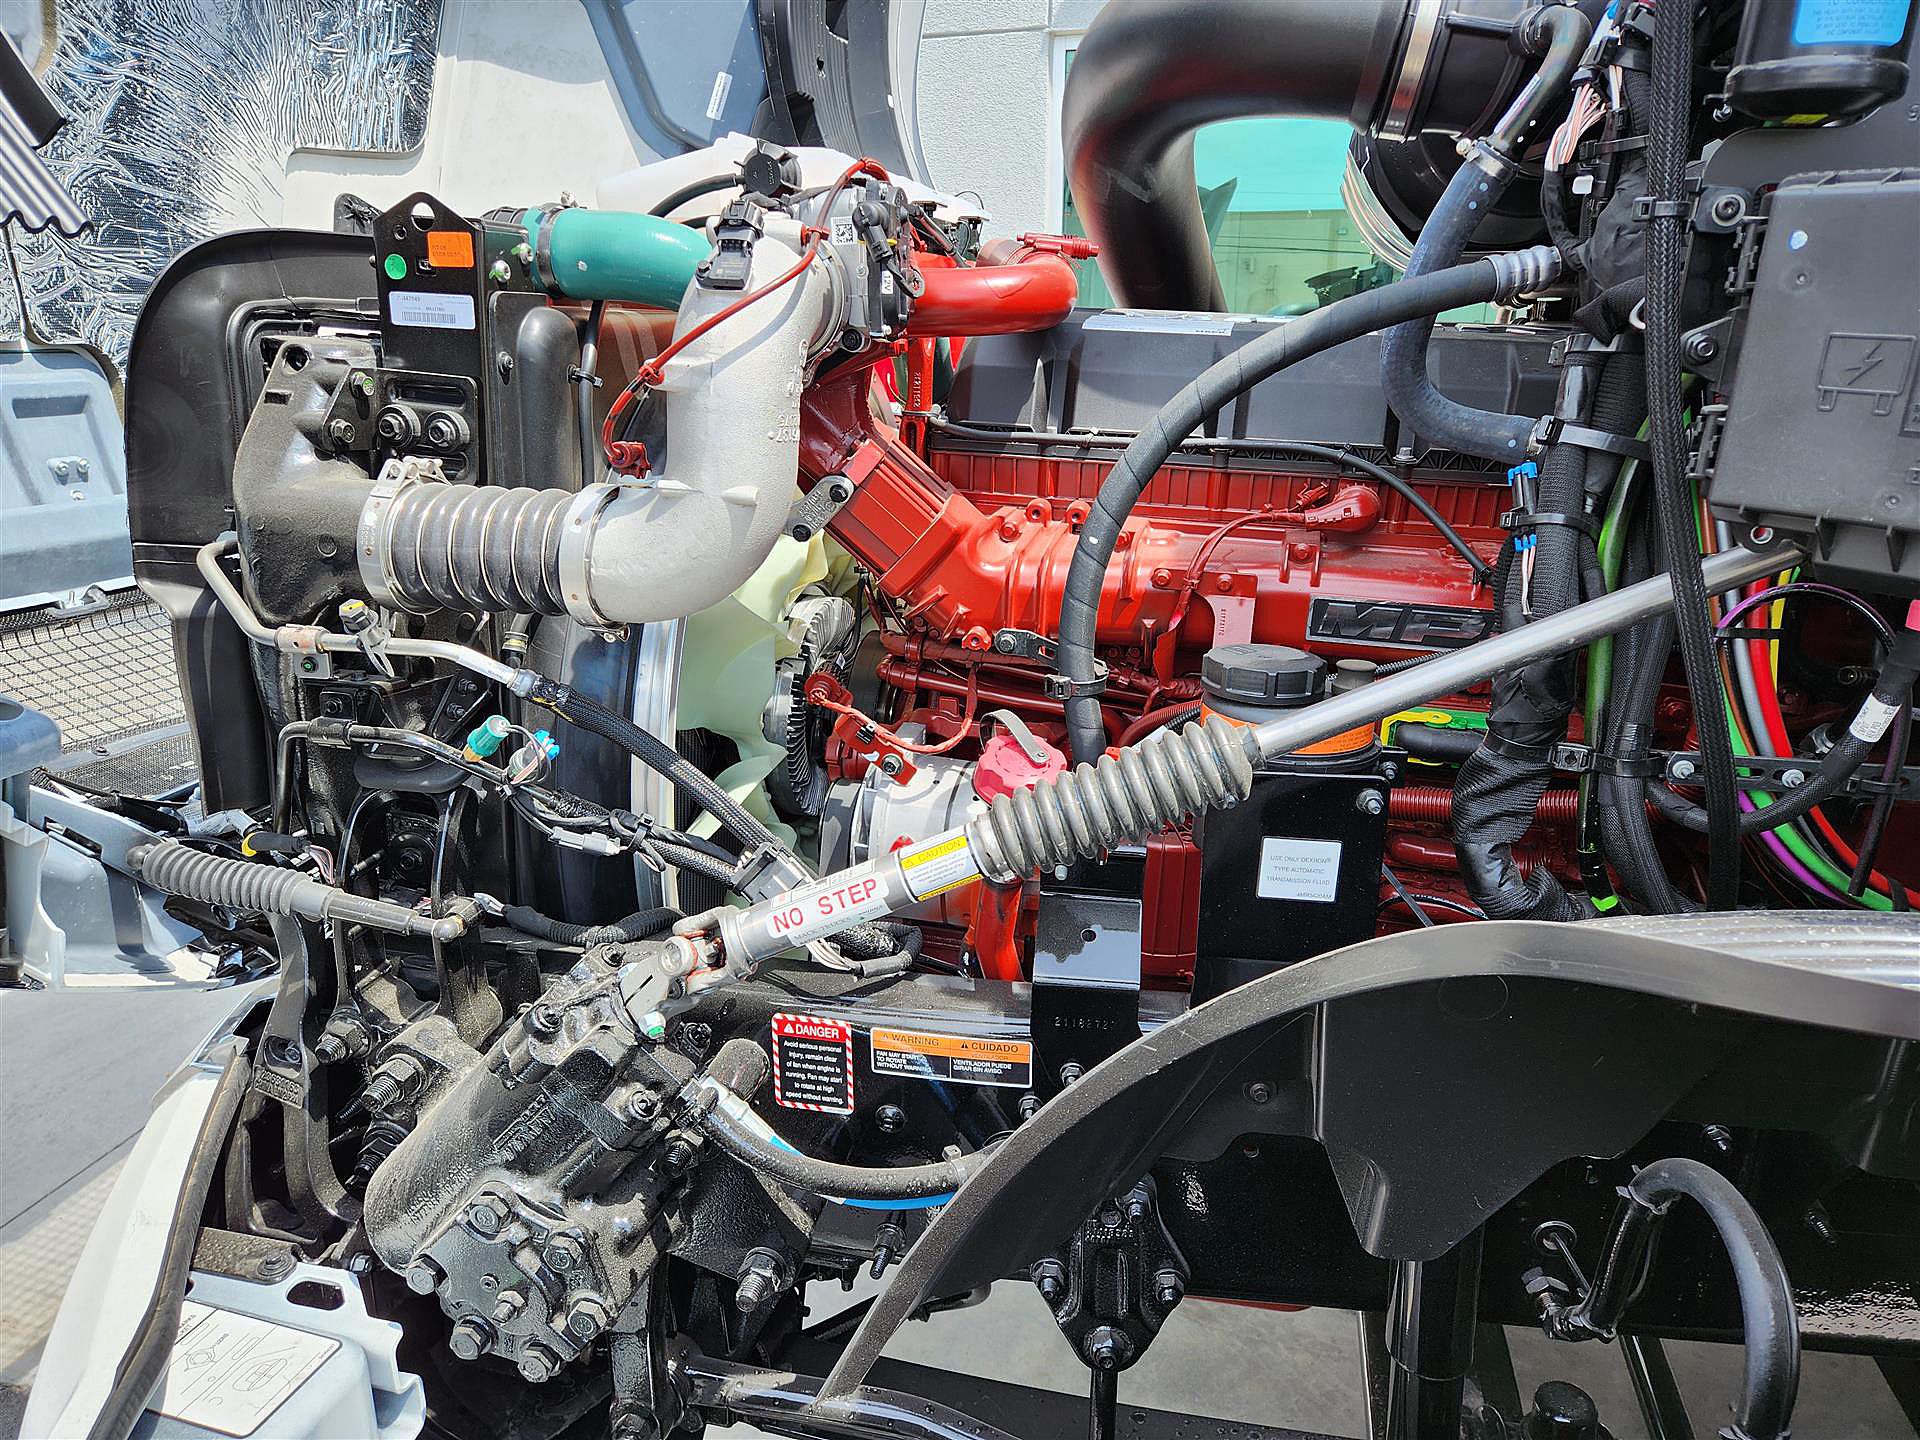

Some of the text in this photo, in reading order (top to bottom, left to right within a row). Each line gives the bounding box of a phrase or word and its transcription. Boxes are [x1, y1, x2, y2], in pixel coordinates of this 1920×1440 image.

[918, 838, 964, 863] CAUTION
[772, 907, 804, 933] NO
[818, 878, 877, 915] STEP
[795, 1024, 839, 1038] DANGER
[892, 1033, 940, 1046] WARNING
[783, 1040, 798, 1048] Avoid
[819, 1045, 842, 1053] personal
[972, 1041, 1019, 1053] CUIDADO
[805, 1053, 823, 1061] remain
[824, 1055, 838, 1063] clear
[876, 1050, 887, 1058] FAN
[876, 1061, 903, 1070] WITHOUT
[886, 1057, 907, 1065] ROTATE
[953, 1059, 1012, 1070] VENTILADOR PUEDE
[817, 1065, 835, 1073] engine
[807, 1073, 817, 1081] Fan
[818, 1075, 829, 1083] may
[830, 1076, 843, 1084] start
[823, 1085, 835, 1093] high
[785, 1091, 801, 1099] speed
[803, 1092, 821, 1101] without
